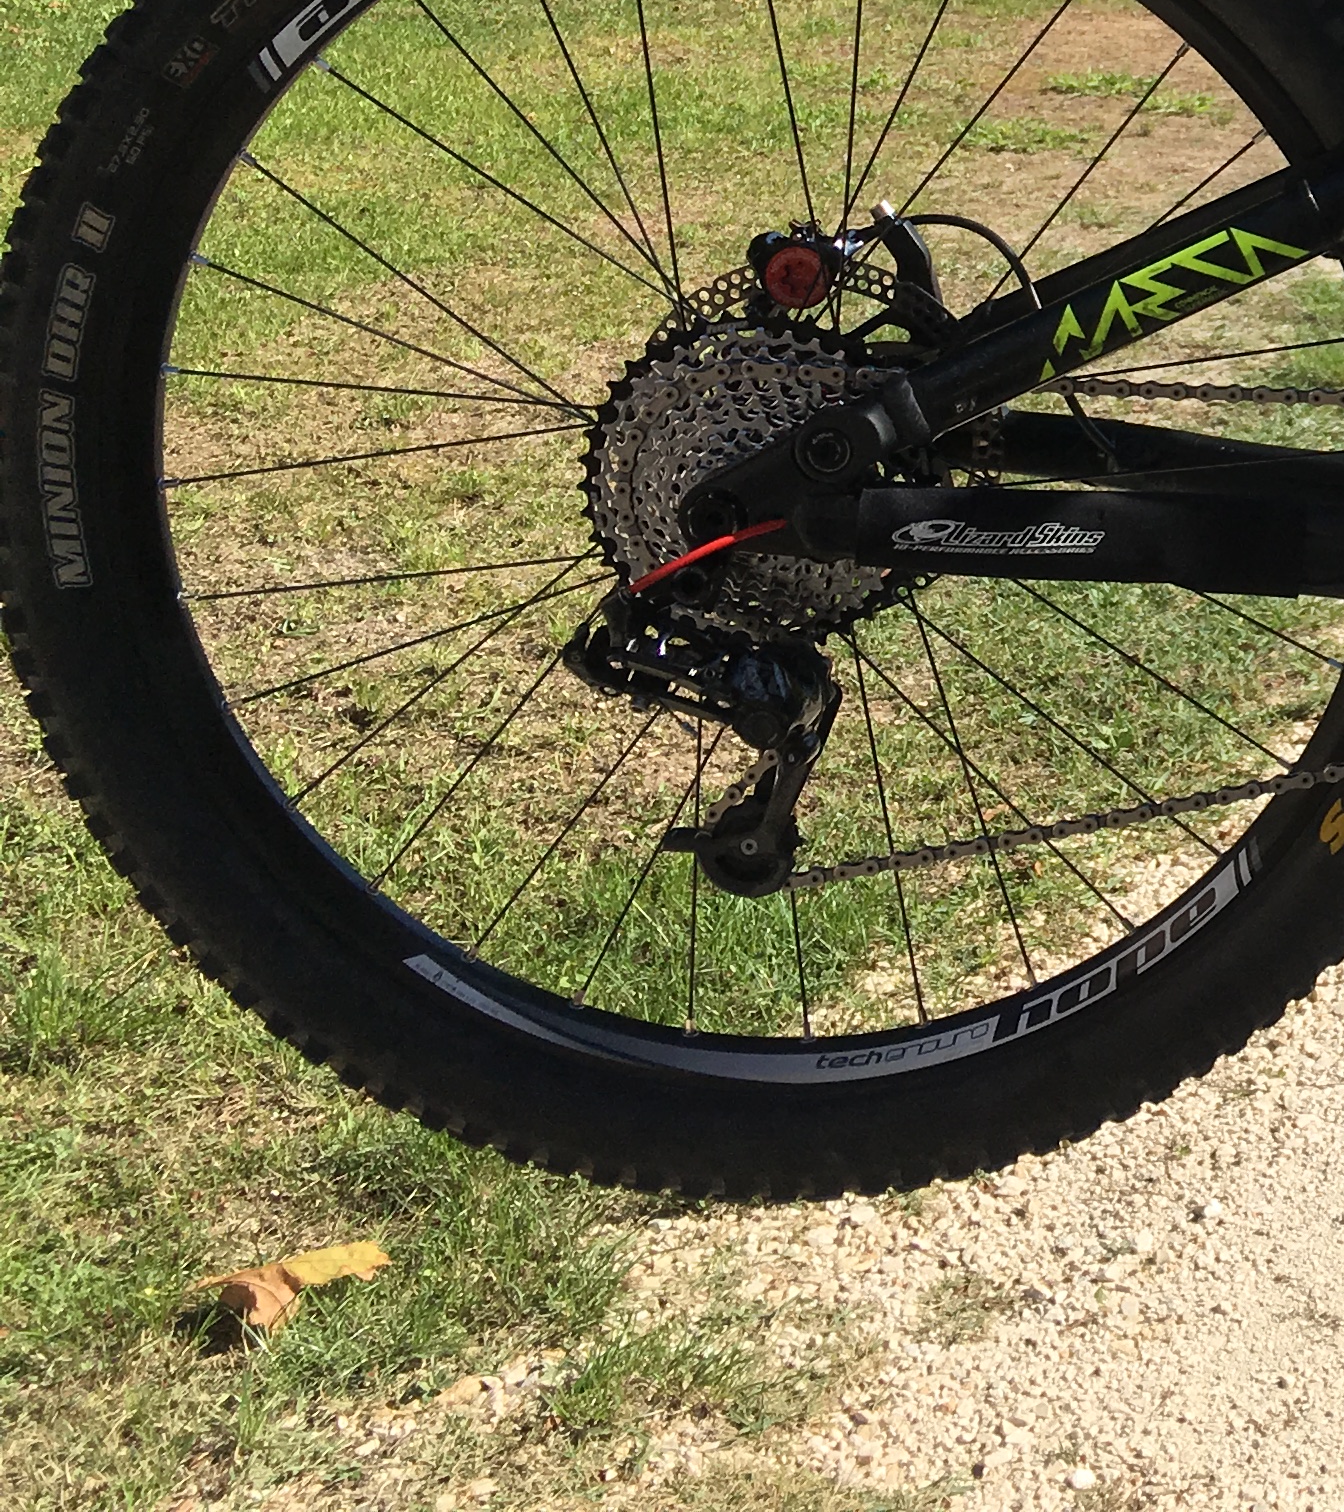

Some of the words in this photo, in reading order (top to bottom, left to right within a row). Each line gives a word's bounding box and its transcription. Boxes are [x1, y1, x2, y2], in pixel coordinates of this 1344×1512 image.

[72, 202, 115, 253] II
[41, 263, 96, 381] DHR
[37, 389, 92, 588] MINION
[941, 522, 1036, 547] Lizard
[1026, 521, 1105, 547] Skins
[993, 887, 1217, 1043] hope
